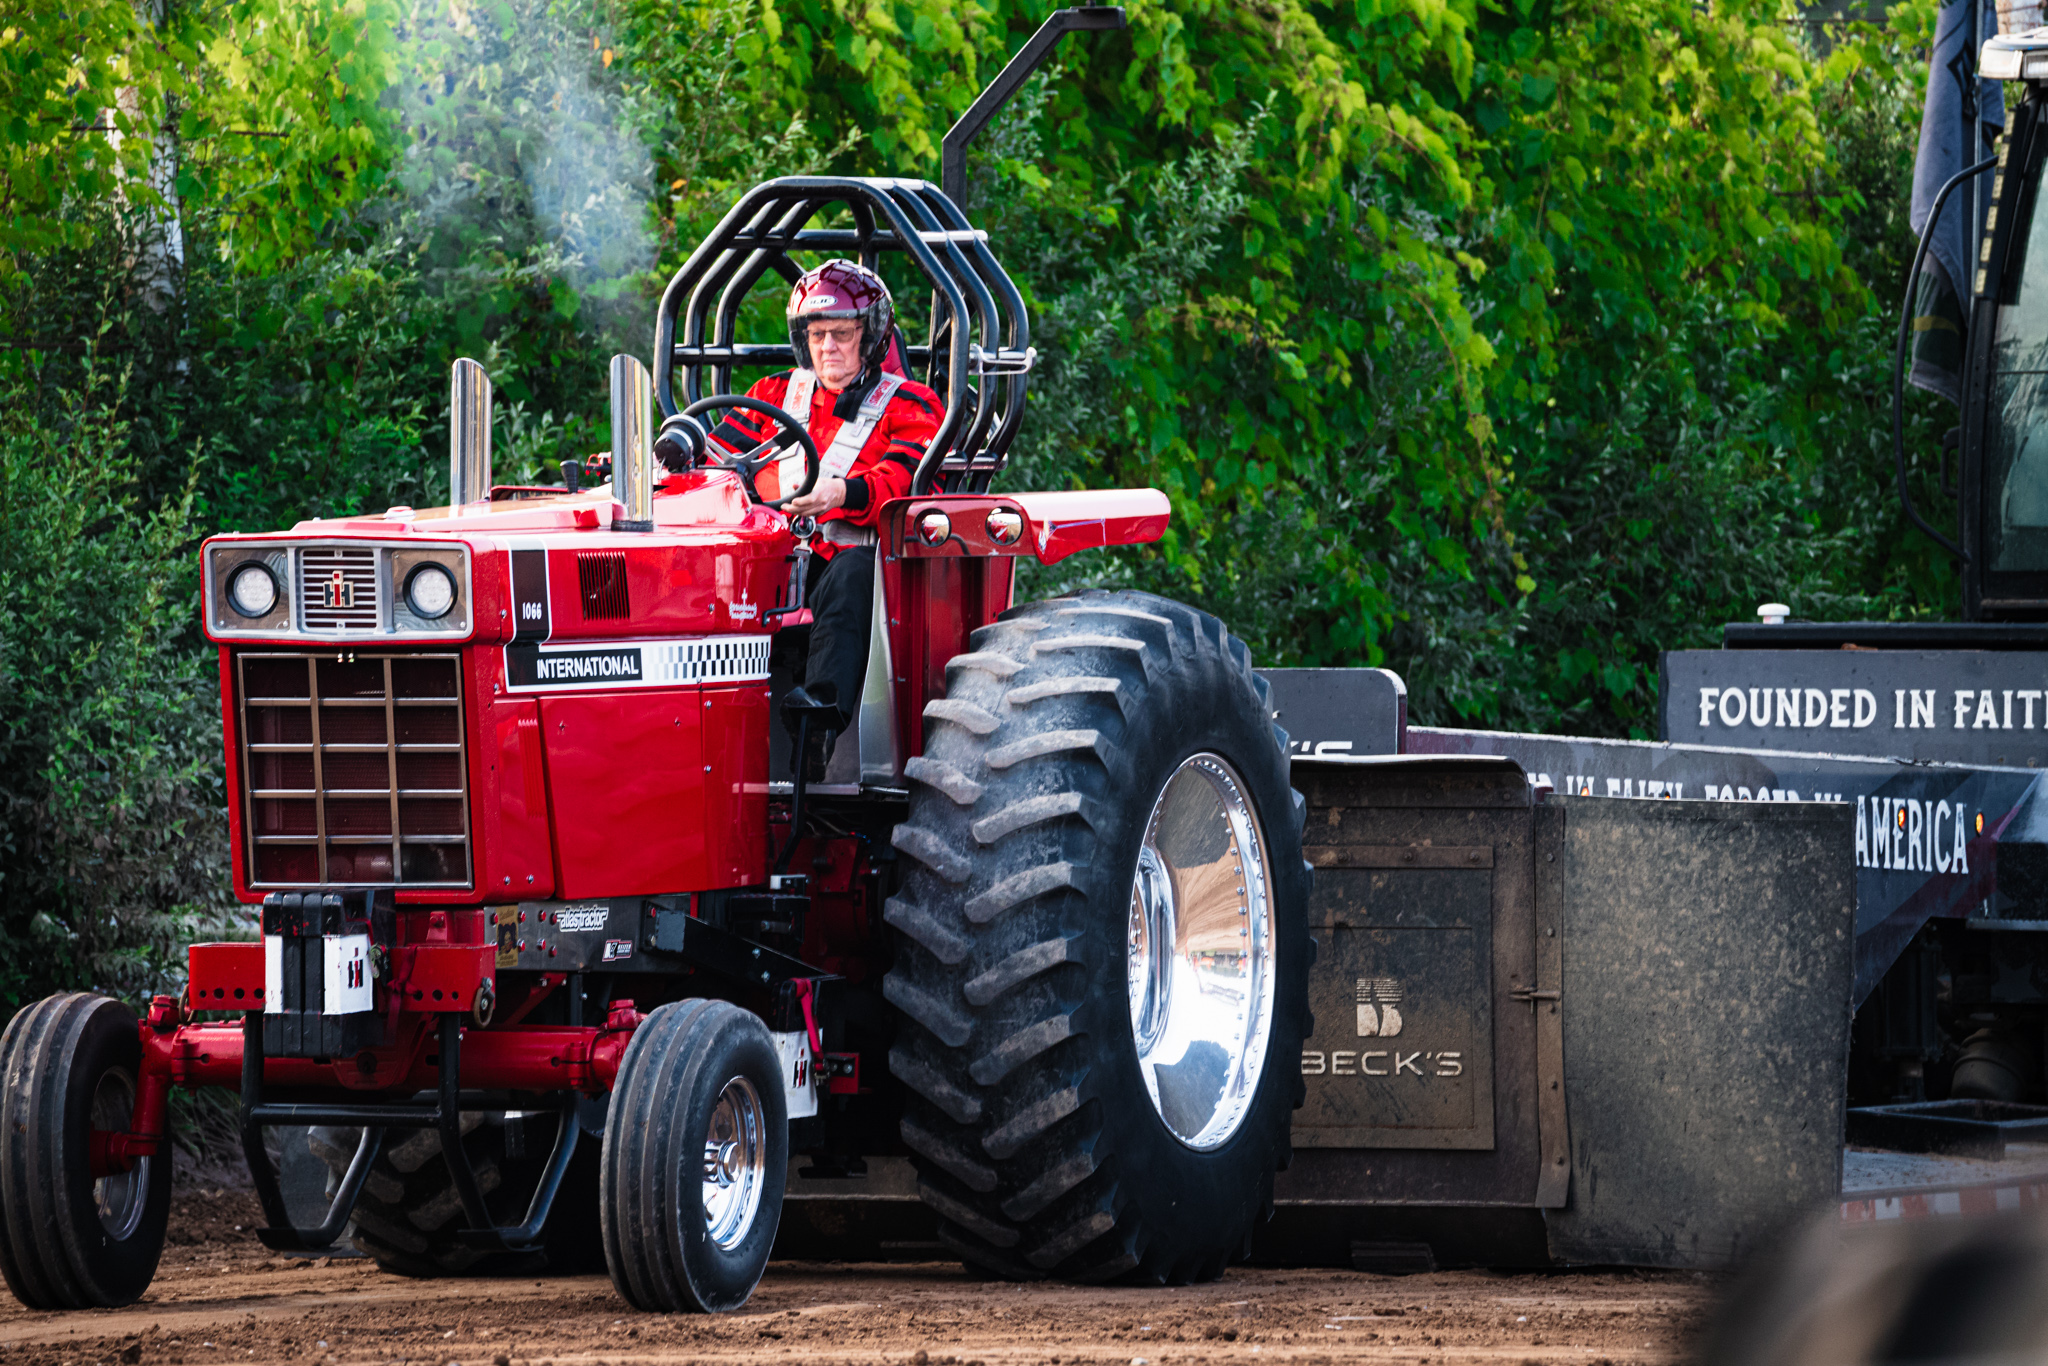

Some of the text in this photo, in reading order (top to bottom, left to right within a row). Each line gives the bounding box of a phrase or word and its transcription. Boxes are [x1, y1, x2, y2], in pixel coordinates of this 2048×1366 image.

[522, 602, 542, 620] 1066
[536, 655, 640, 679] INTERNATIONAL
[1699, 687, 2048, 729] FOUNDED IN FAIT
[1855, 795, 1969, 874] AMERICA
[1301, 1051, 1463, 1086] BECK'S
